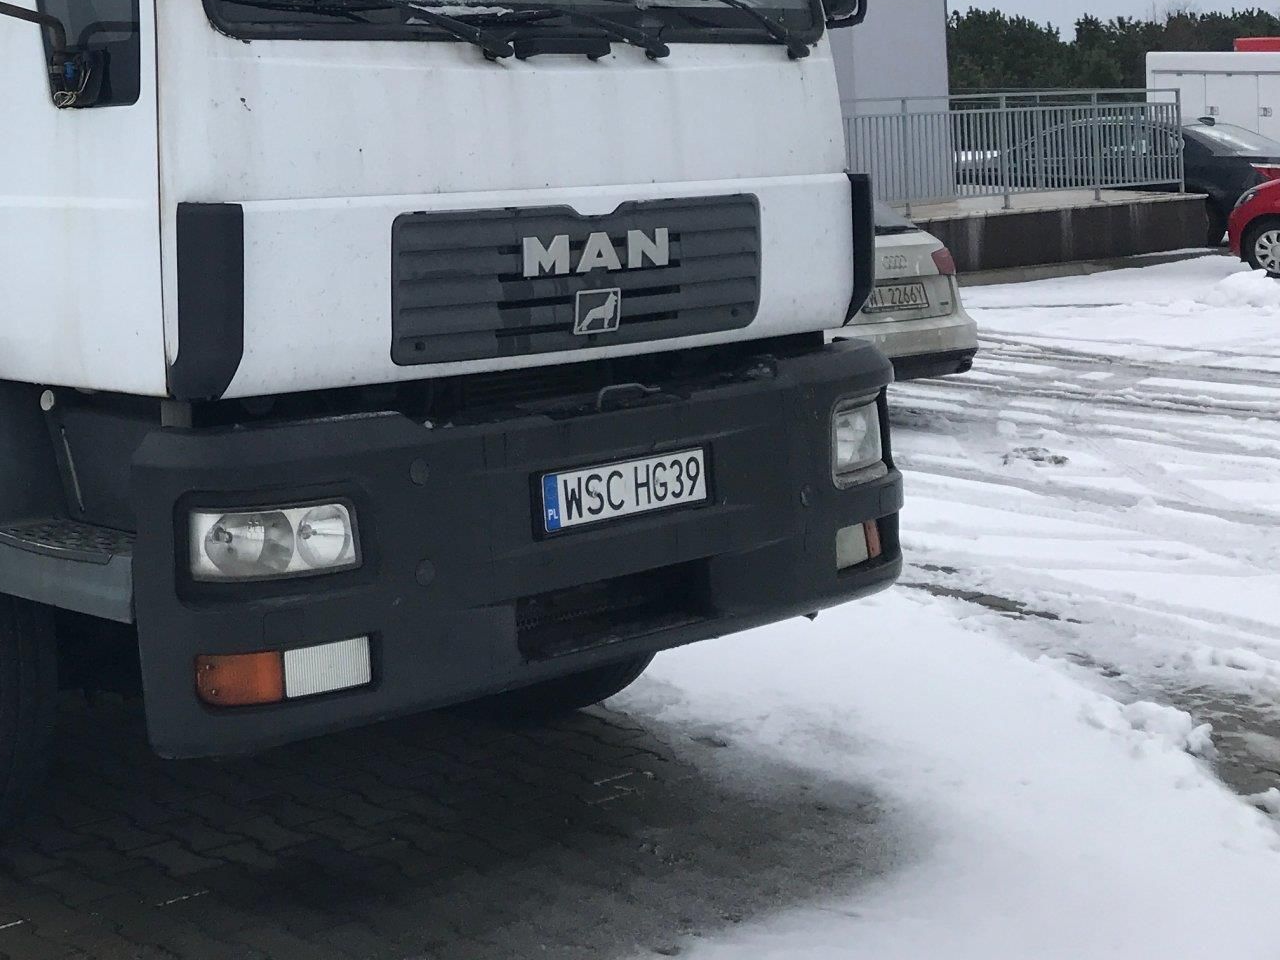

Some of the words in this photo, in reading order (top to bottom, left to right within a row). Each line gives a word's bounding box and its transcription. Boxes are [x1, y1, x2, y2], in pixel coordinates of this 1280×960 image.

[523, 227, 670, 277] MAN
[563, 470, 625, 521] WSC
[634, 456, 700, 506] HG39
[548, 509, 559, 520] PL
